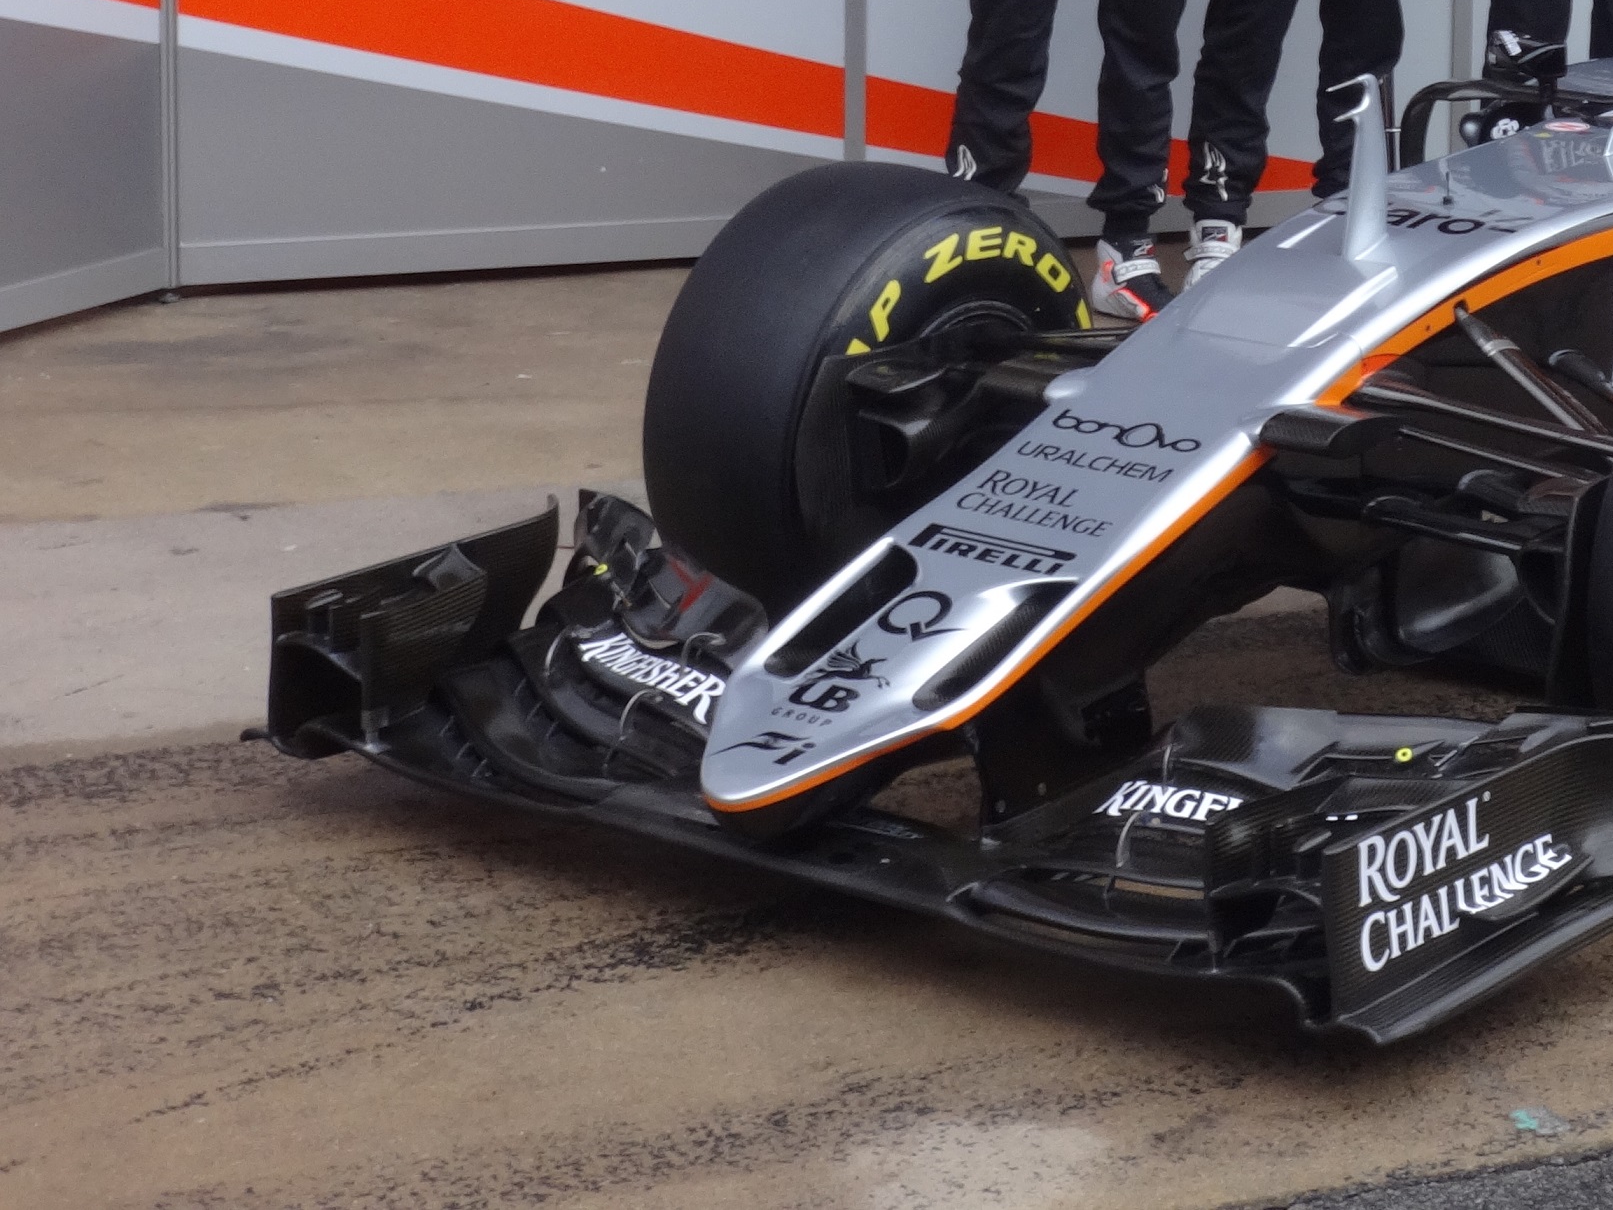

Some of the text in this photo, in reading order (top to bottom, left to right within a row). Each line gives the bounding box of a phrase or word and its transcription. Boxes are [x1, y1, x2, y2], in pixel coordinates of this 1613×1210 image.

[868, 279, 902, 343] P
[923, 225, 1072, 294] ZERO
[1016, 440, 1175, 483] URALCHEM
[955, 491, 1114, 539] CHALLENGE
[976, 469, 1080, 509] ROYAL
[907, 522, 1078, 576] PIRELLI
[577, 631, 728, 725] KINGFISHER
[770, 706, 833, 727] GROUP
[1356, 796, 1491, 908] ROYAL
[1360, 833, 1573, 973] CHALLENGE
